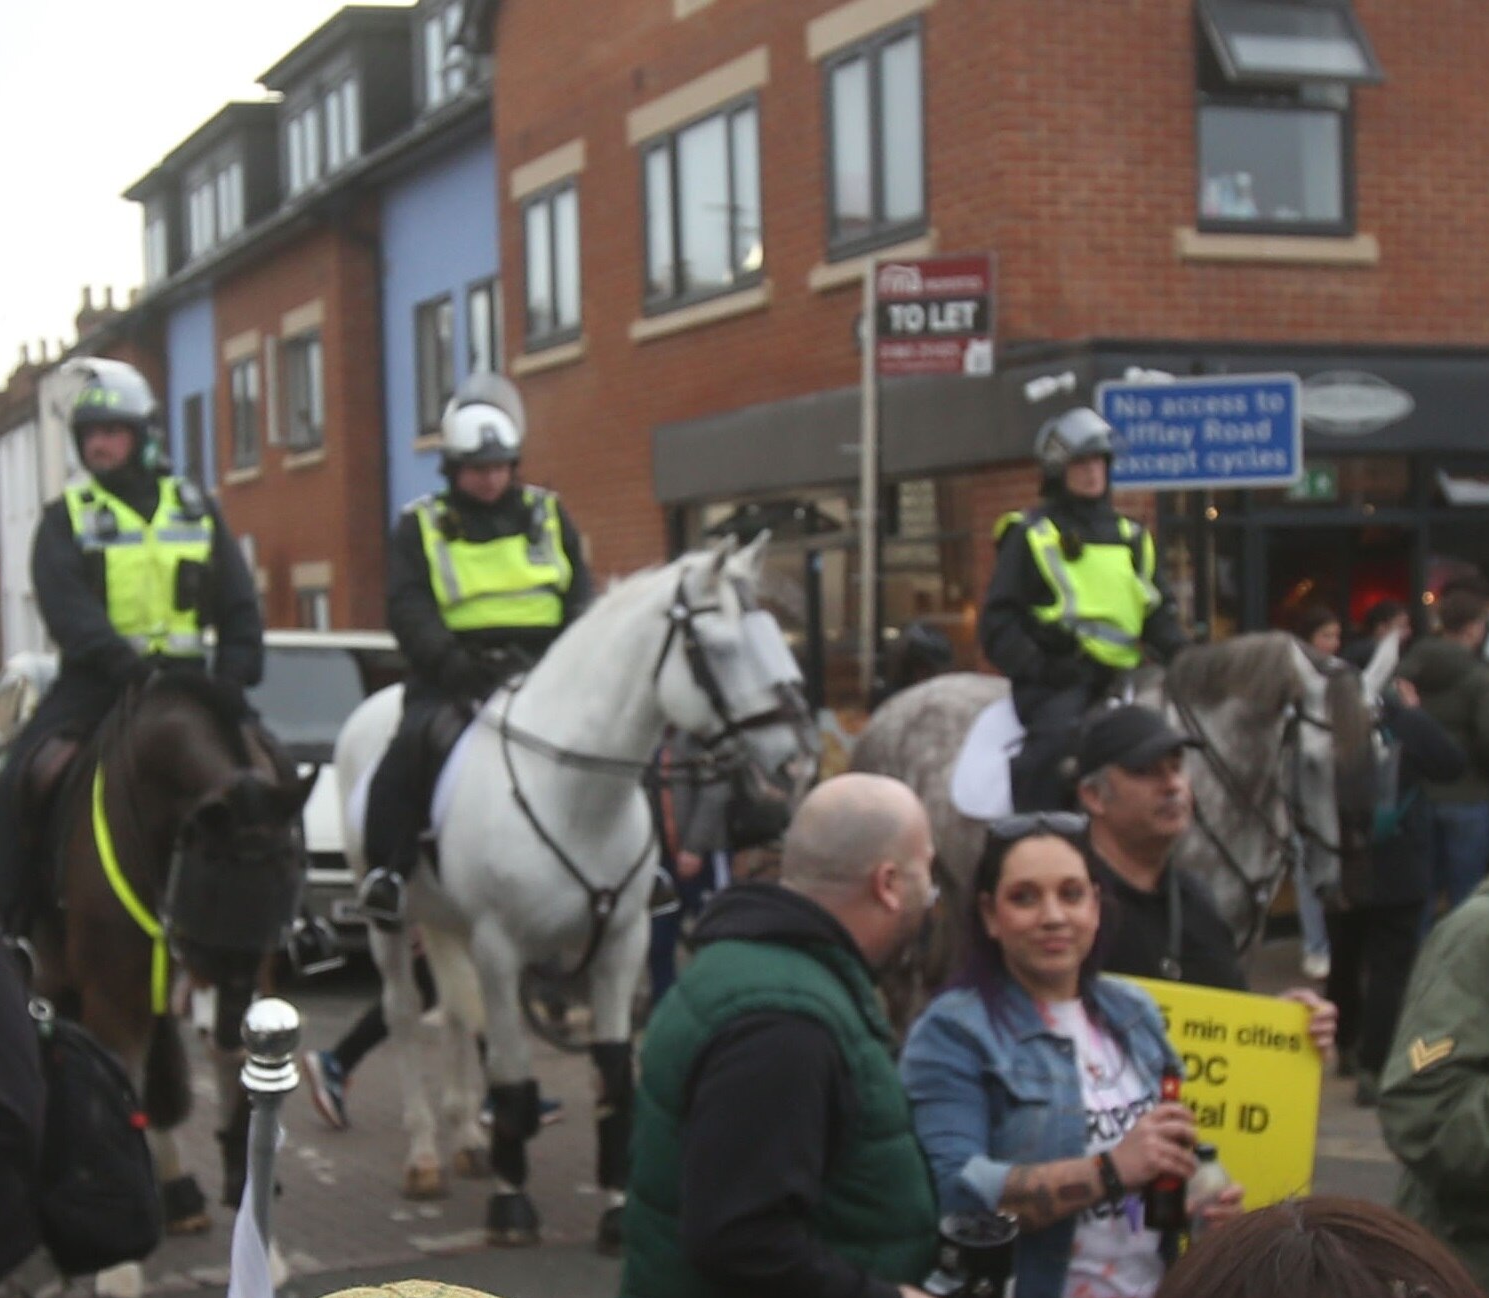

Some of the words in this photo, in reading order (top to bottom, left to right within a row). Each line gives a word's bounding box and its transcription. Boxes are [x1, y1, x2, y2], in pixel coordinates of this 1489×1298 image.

[888, 301, 925, 334] TO
[928, 300, 976, 332] LET
[1113, 394, 1153, 418] No
[1161, 394, 1248, 418] access
[1254, 389, 1286, 414] to
[1202, 417, 1273, 444] Road
[1204, 445, 1288, 476] cycles
[1183, 1018, 1228, 1042] min
[1235, 1026, 1302, 1053] cities
[1181, 1052, 1229, 1087] DC
[1238, 1104, 1270, 1134] ID
